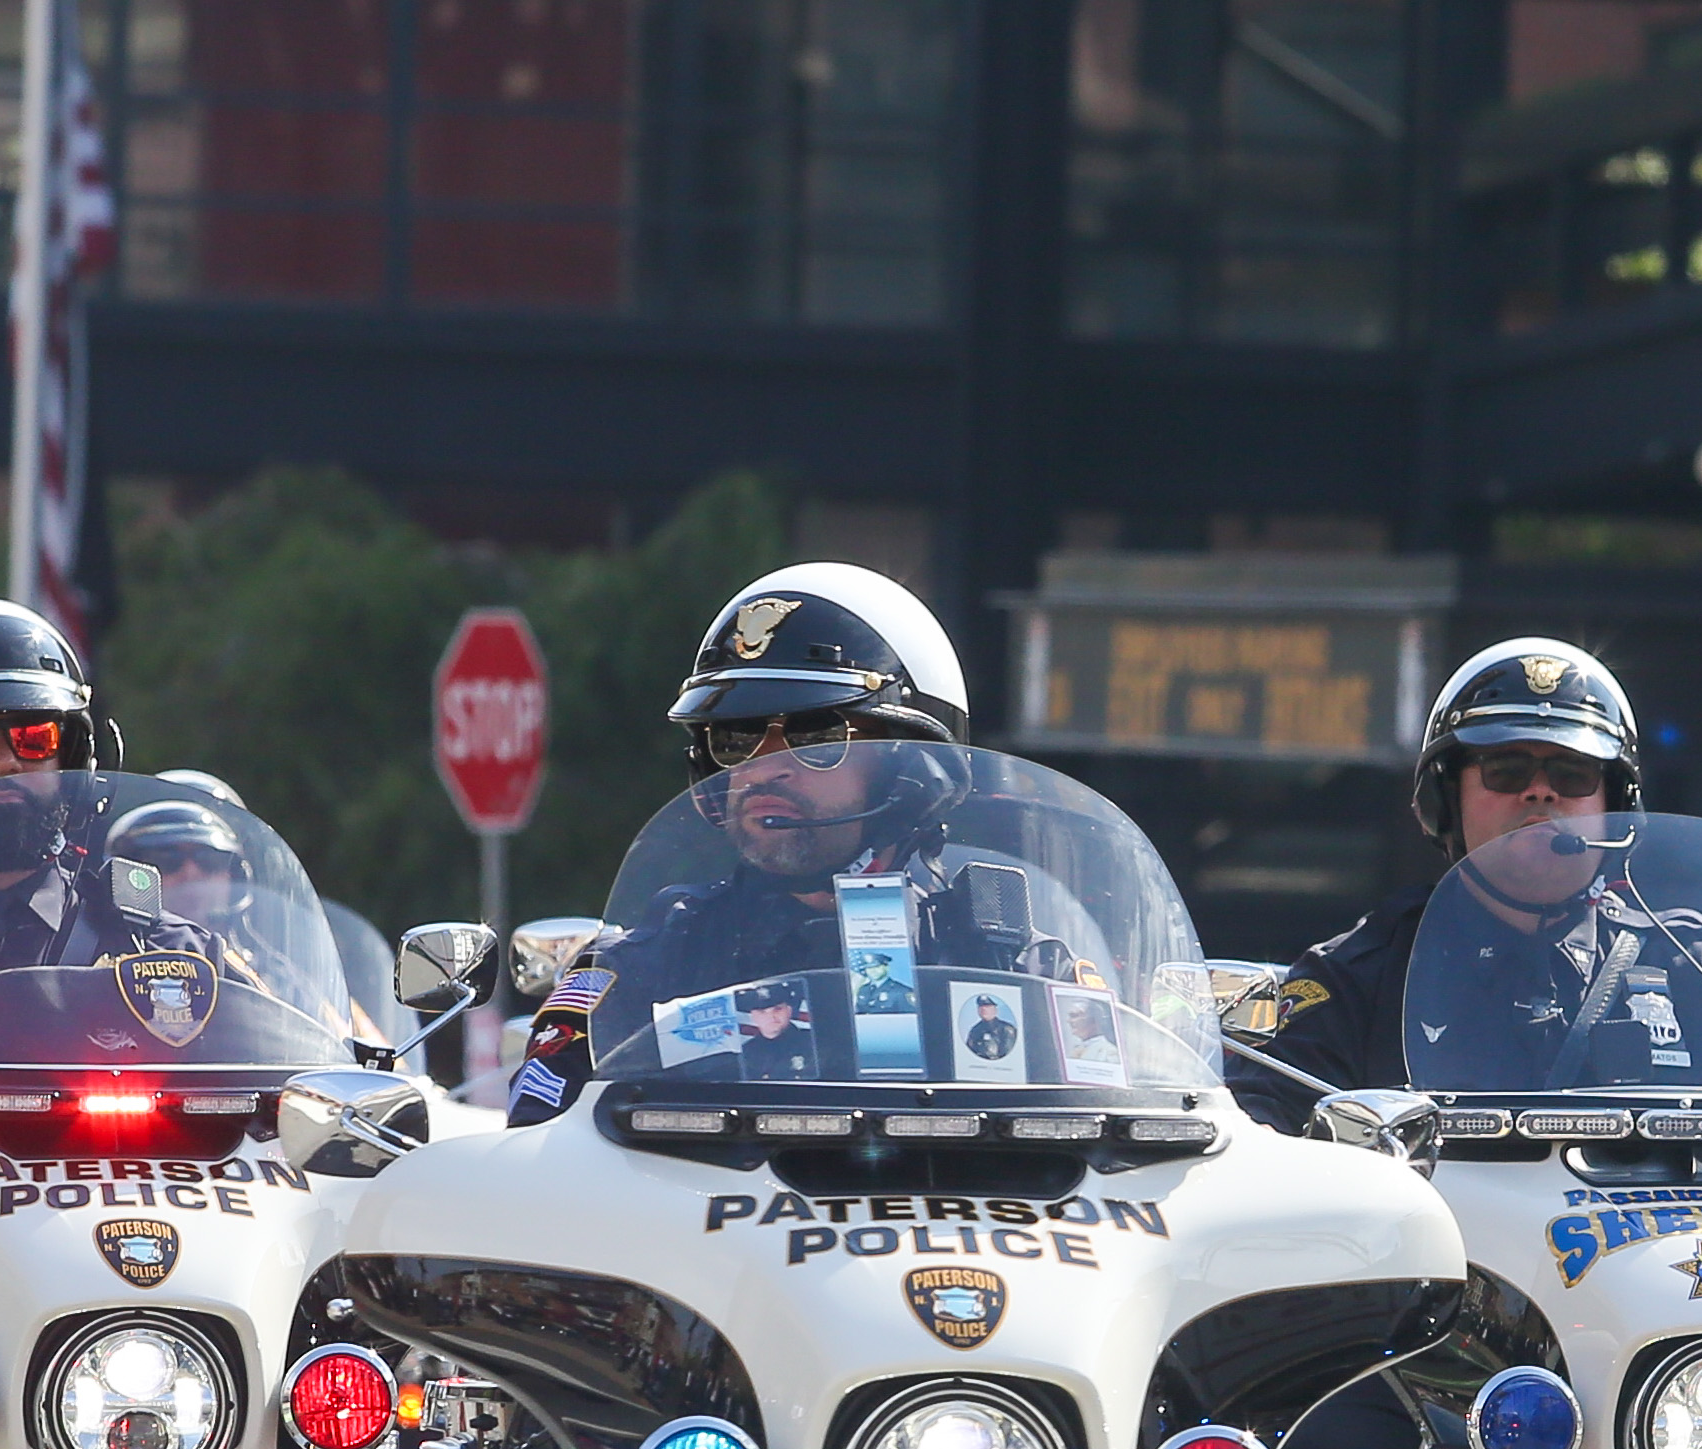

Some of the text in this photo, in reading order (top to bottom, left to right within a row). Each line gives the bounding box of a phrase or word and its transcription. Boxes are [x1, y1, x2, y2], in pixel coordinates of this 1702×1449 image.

[442, 679, 546, 761] STOP
[132, 961, 198, 979] PATERSON
[154, 1007, 194, 1023] POLICE
[704, 1192, 1170, 1240] PATERSON
[101, 1221, 172, 1240] PATERSON
[786, 1225, 1101, 1269] POLICE
[121, 1263, 166, 1278] POLICE
[912, 1270, 999, 1292] PATERSON
[934, 1320, 988, 1337] POLICE
